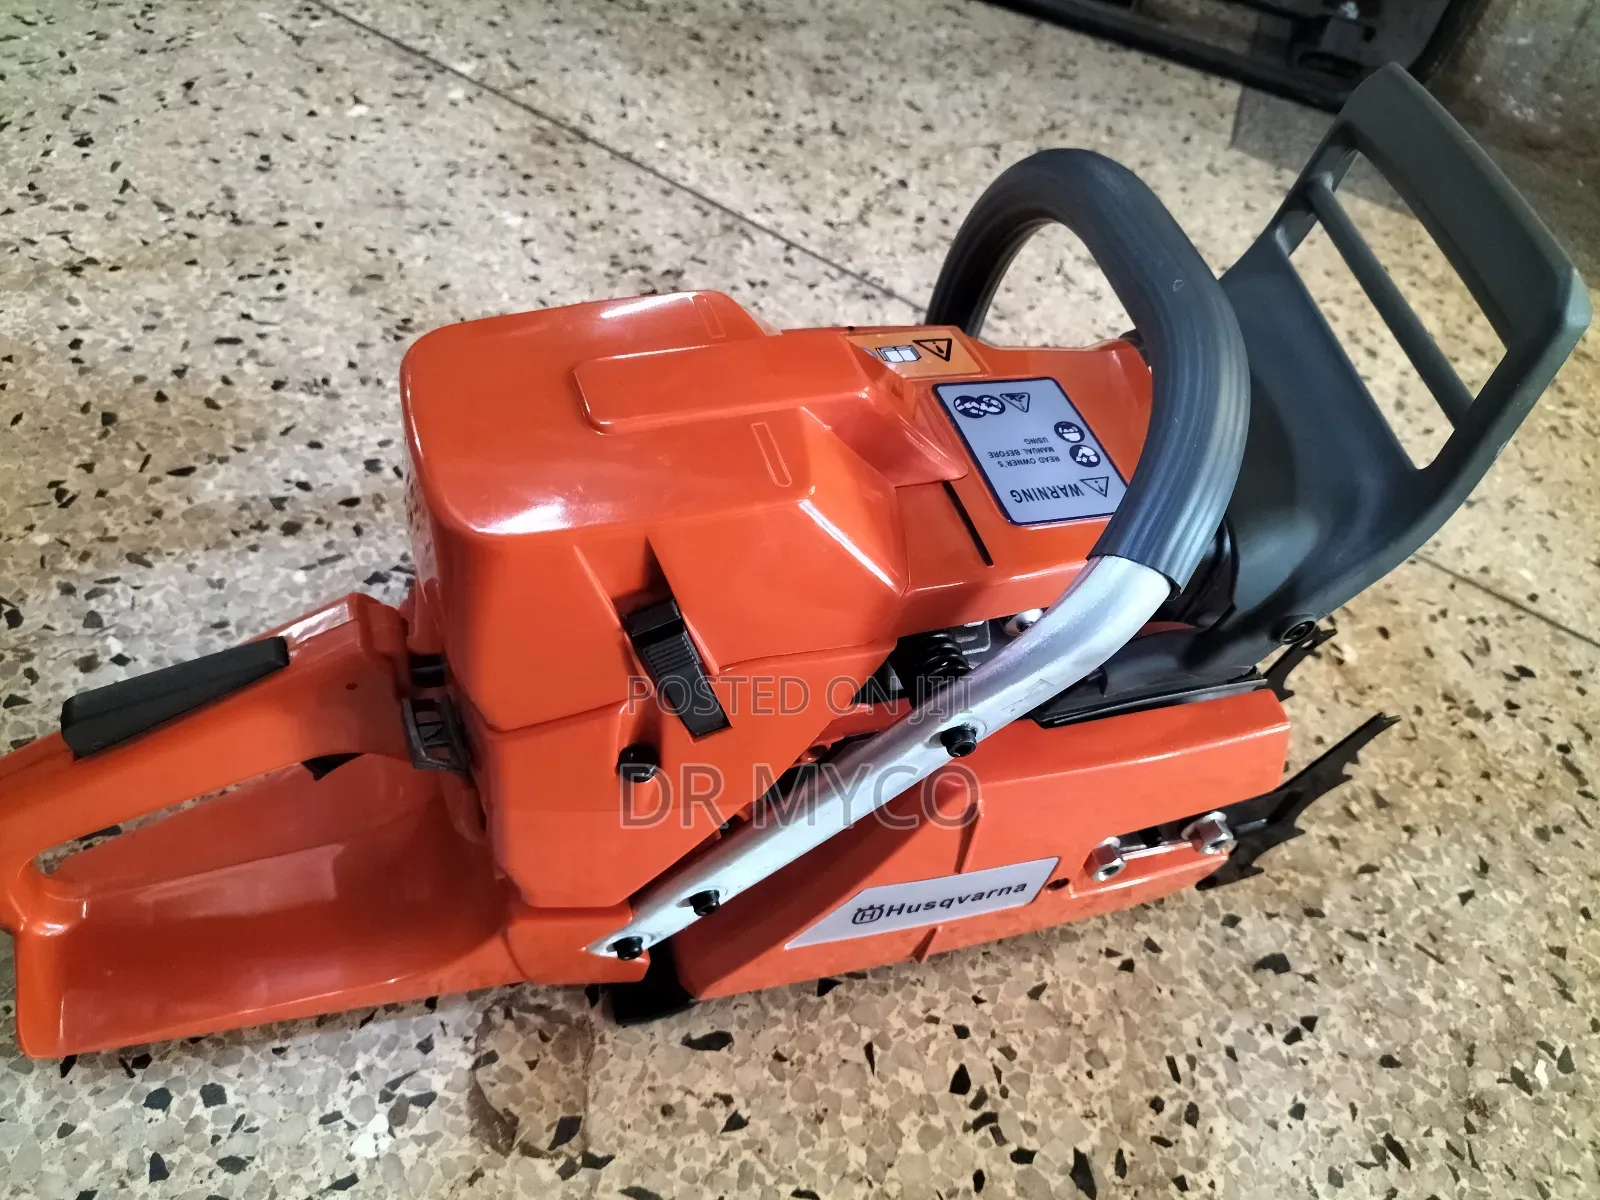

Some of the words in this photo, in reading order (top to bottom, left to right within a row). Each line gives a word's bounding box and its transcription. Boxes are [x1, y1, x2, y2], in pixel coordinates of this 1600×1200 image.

[1023, 436, 1049, 445] USING
[987, 448, 1021, 458] BEFORE
[1022, 446, 1055, 455] MANUAL
[997, 457, 1037, 468] OWNER'S
[1039, 455, 1061, 464] READ
[1009, 483, 1085, 503] WARNING
[885, 881, 1028, 919] Husqvarna
